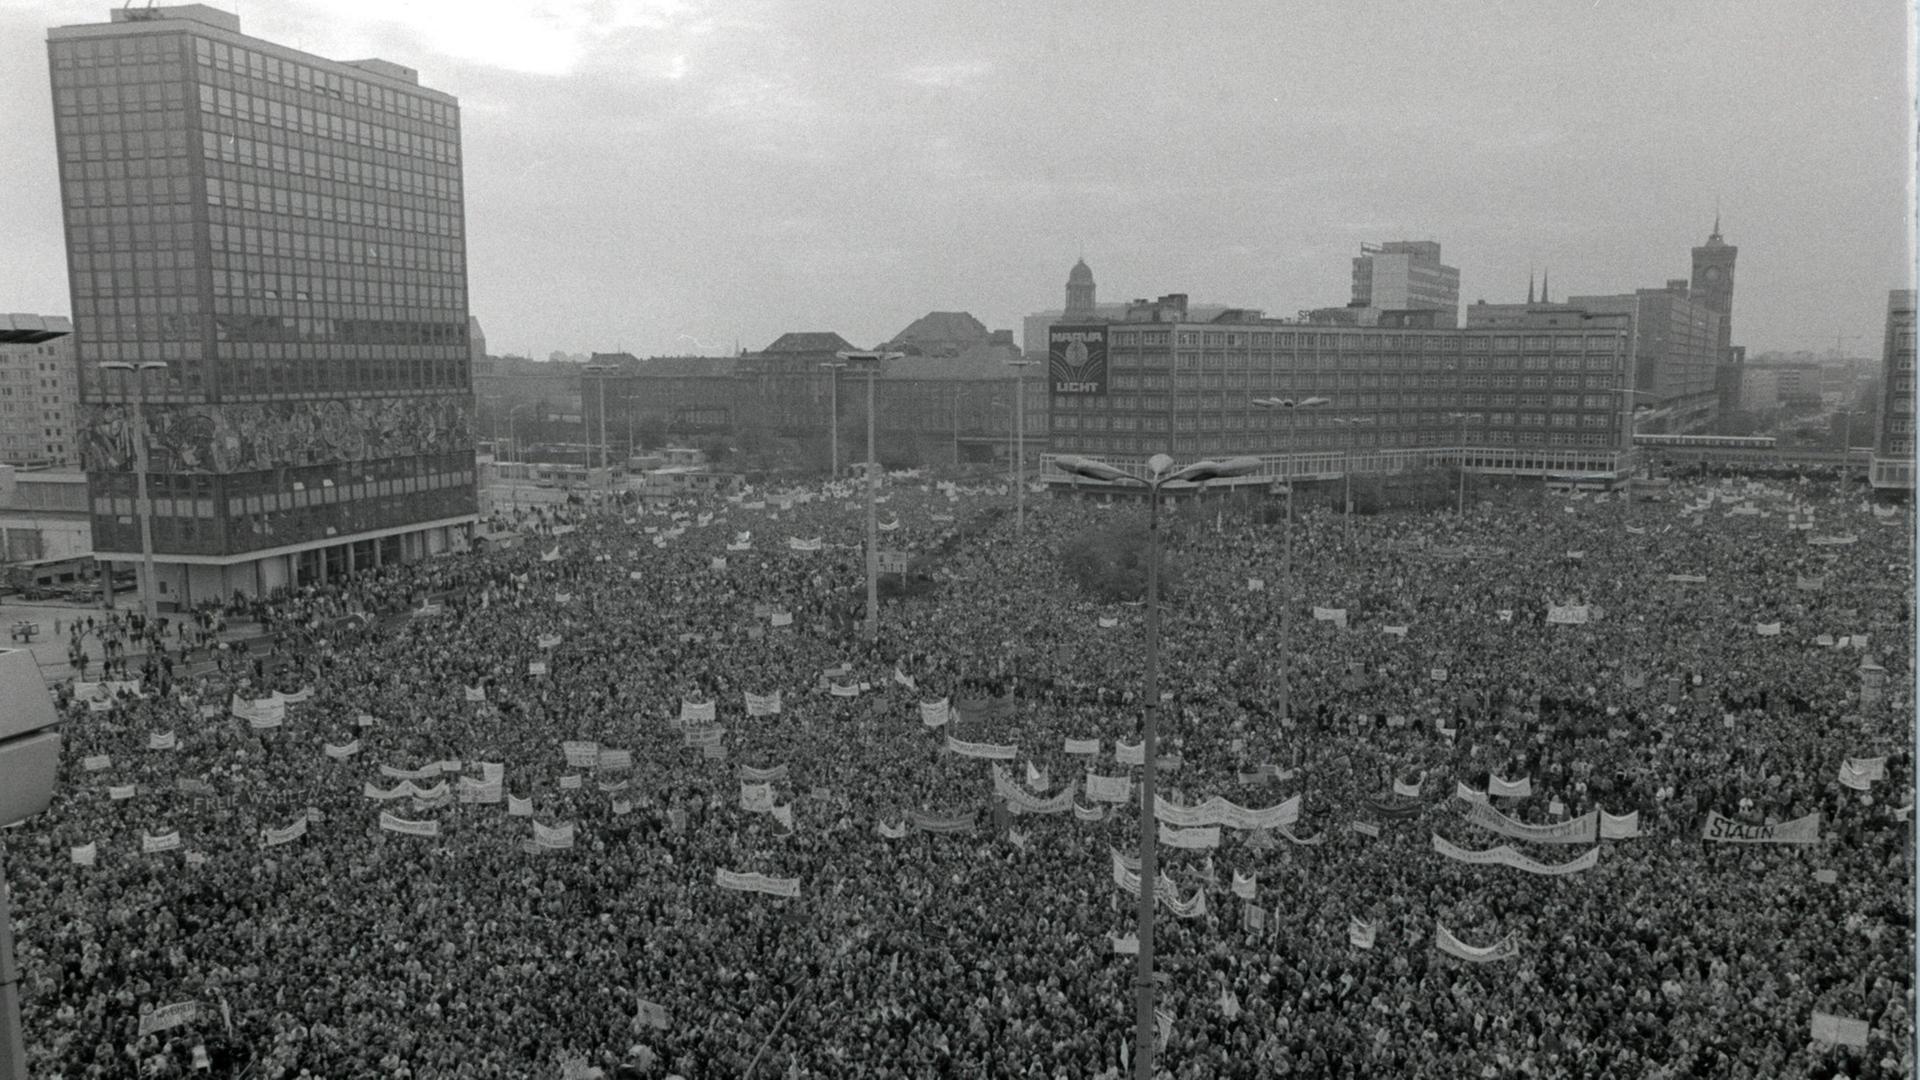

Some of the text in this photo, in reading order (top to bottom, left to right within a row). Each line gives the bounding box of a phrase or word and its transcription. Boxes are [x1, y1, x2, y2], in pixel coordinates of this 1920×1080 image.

[1051, 331, 1103, 342] NARVA
[1056, 381, 1099, 393] LICHT
[193, 782, 321, 810] FREIE WAHLEN
[1710, 817, 1775, 840] STALIN
